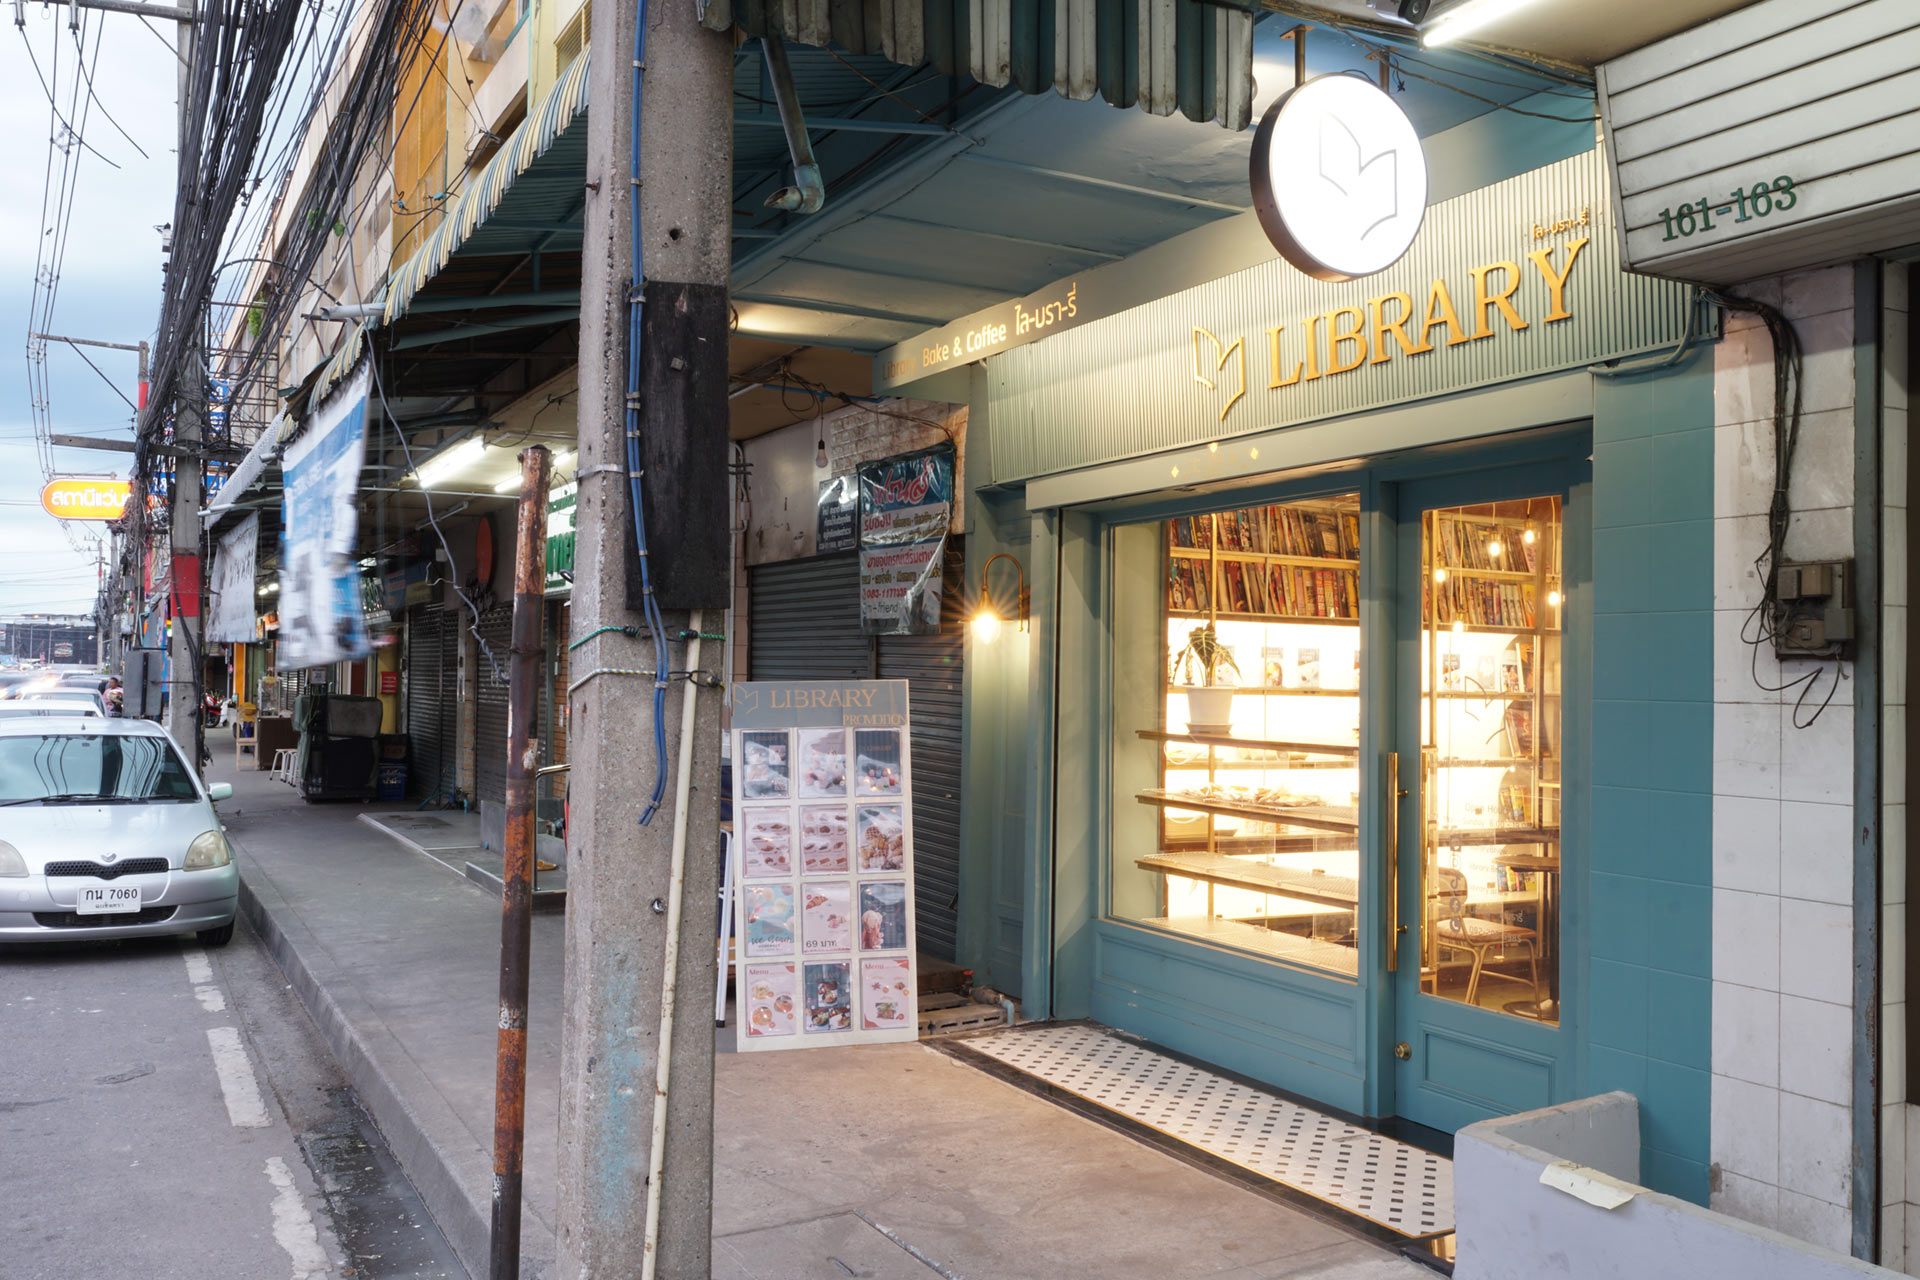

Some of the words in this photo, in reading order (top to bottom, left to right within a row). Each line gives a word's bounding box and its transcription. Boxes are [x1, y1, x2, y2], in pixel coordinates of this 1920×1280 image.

[1659, 175, 1797, 242] 161-163
[1265, 237, 1589, 389] LIBRARY
[922, 343, 949, 368] Bake
[953, 336, 962, 357] &
[966, 323, 1007, 353] Coffee
[770, 689, 877, 709] LIBRARY
[843, 713, 907, 726] PROMOTION
[86, 889, 103, 901] กน
[109, 888, 138, 900] 7060
[806, 940, 818, 948] 69
